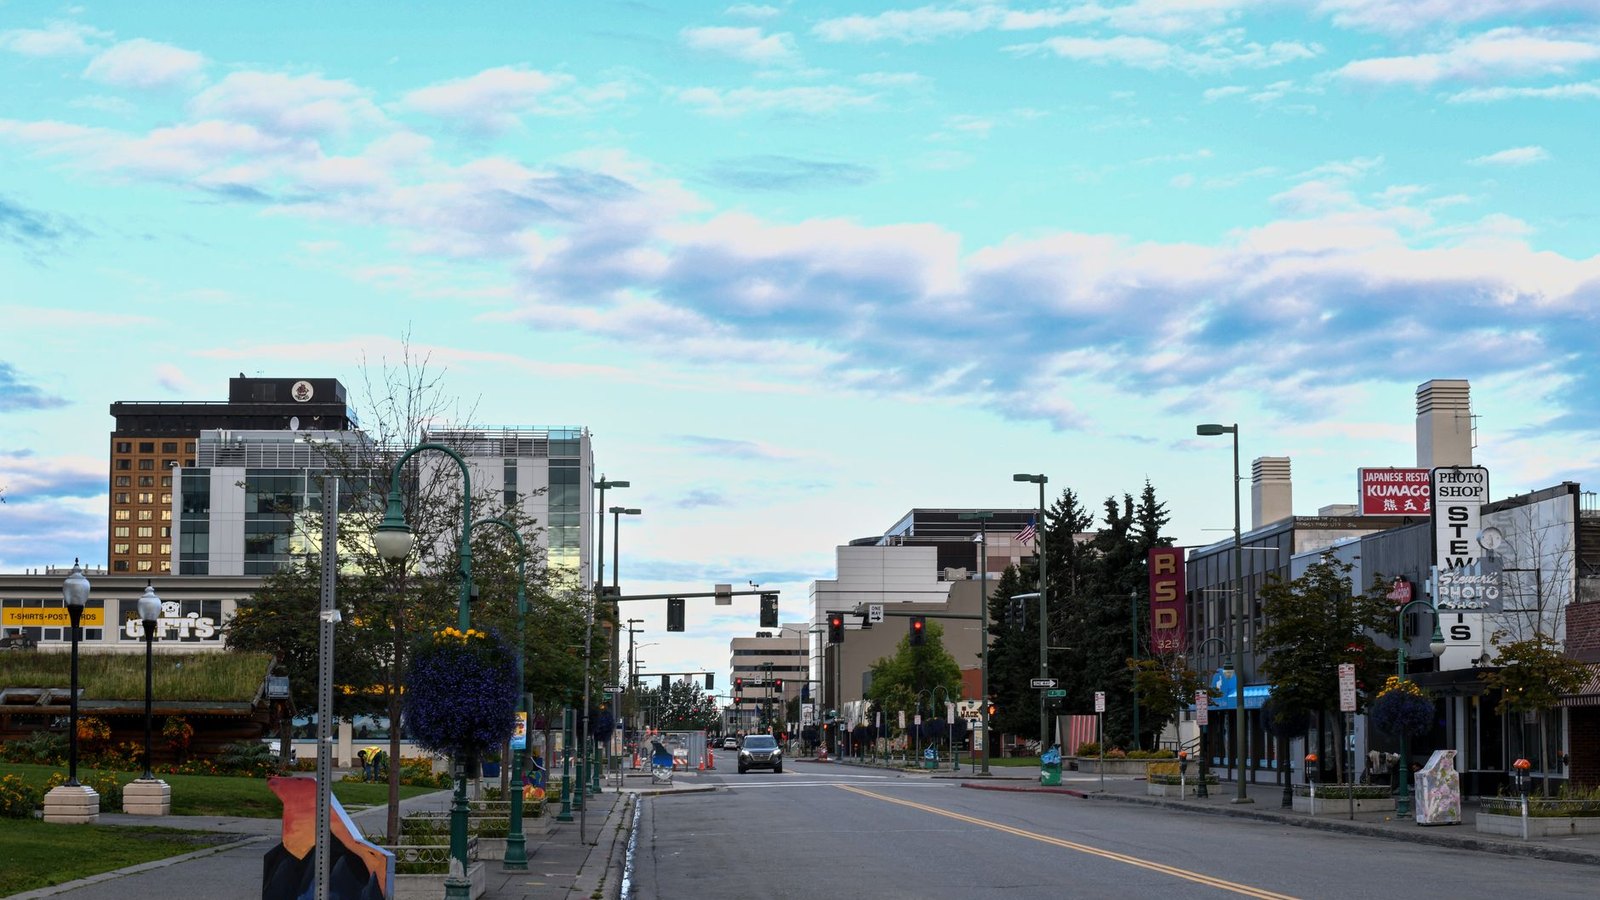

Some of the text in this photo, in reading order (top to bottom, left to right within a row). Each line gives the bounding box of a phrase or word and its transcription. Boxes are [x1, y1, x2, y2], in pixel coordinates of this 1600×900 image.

[1364, 472, 1404, 482] JAPANESE
[1439, 472, 1483, 484] PHOTO
[1440, 486, 1483, 497] SHOP
[1155, 553, 1178, 630] RSD
[1439, 586, 1499, 600] PHOTO
[1447, 601, 1490, 609] SHOP
[10, 613, 96, 621] T-SHIRTS POSTRDS
[126, 617, 215, 638] GFTS
